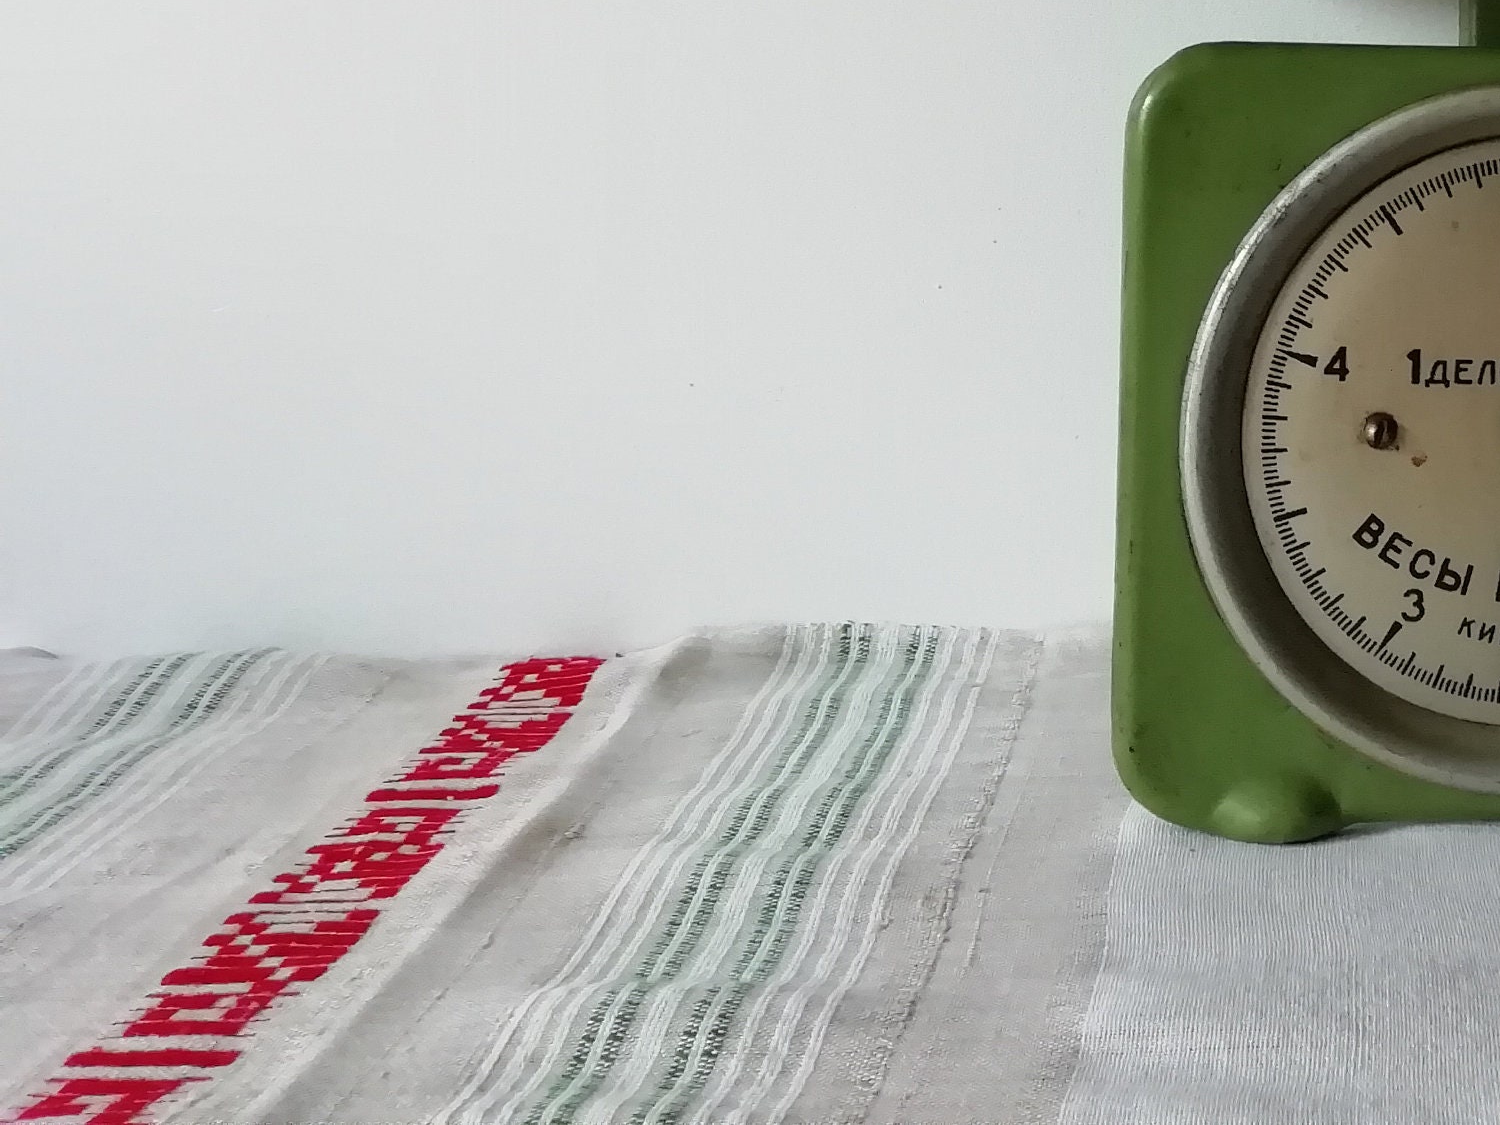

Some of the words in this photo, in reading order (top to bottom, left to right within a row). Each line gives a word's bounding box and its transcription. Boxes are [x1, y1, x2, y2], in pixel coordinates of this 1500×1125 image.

[1324, 347, 1350, 382] 4
[1352, 513, 1474, 596] ВЕСЫ
[1401, 588, 1426, 623] 3
